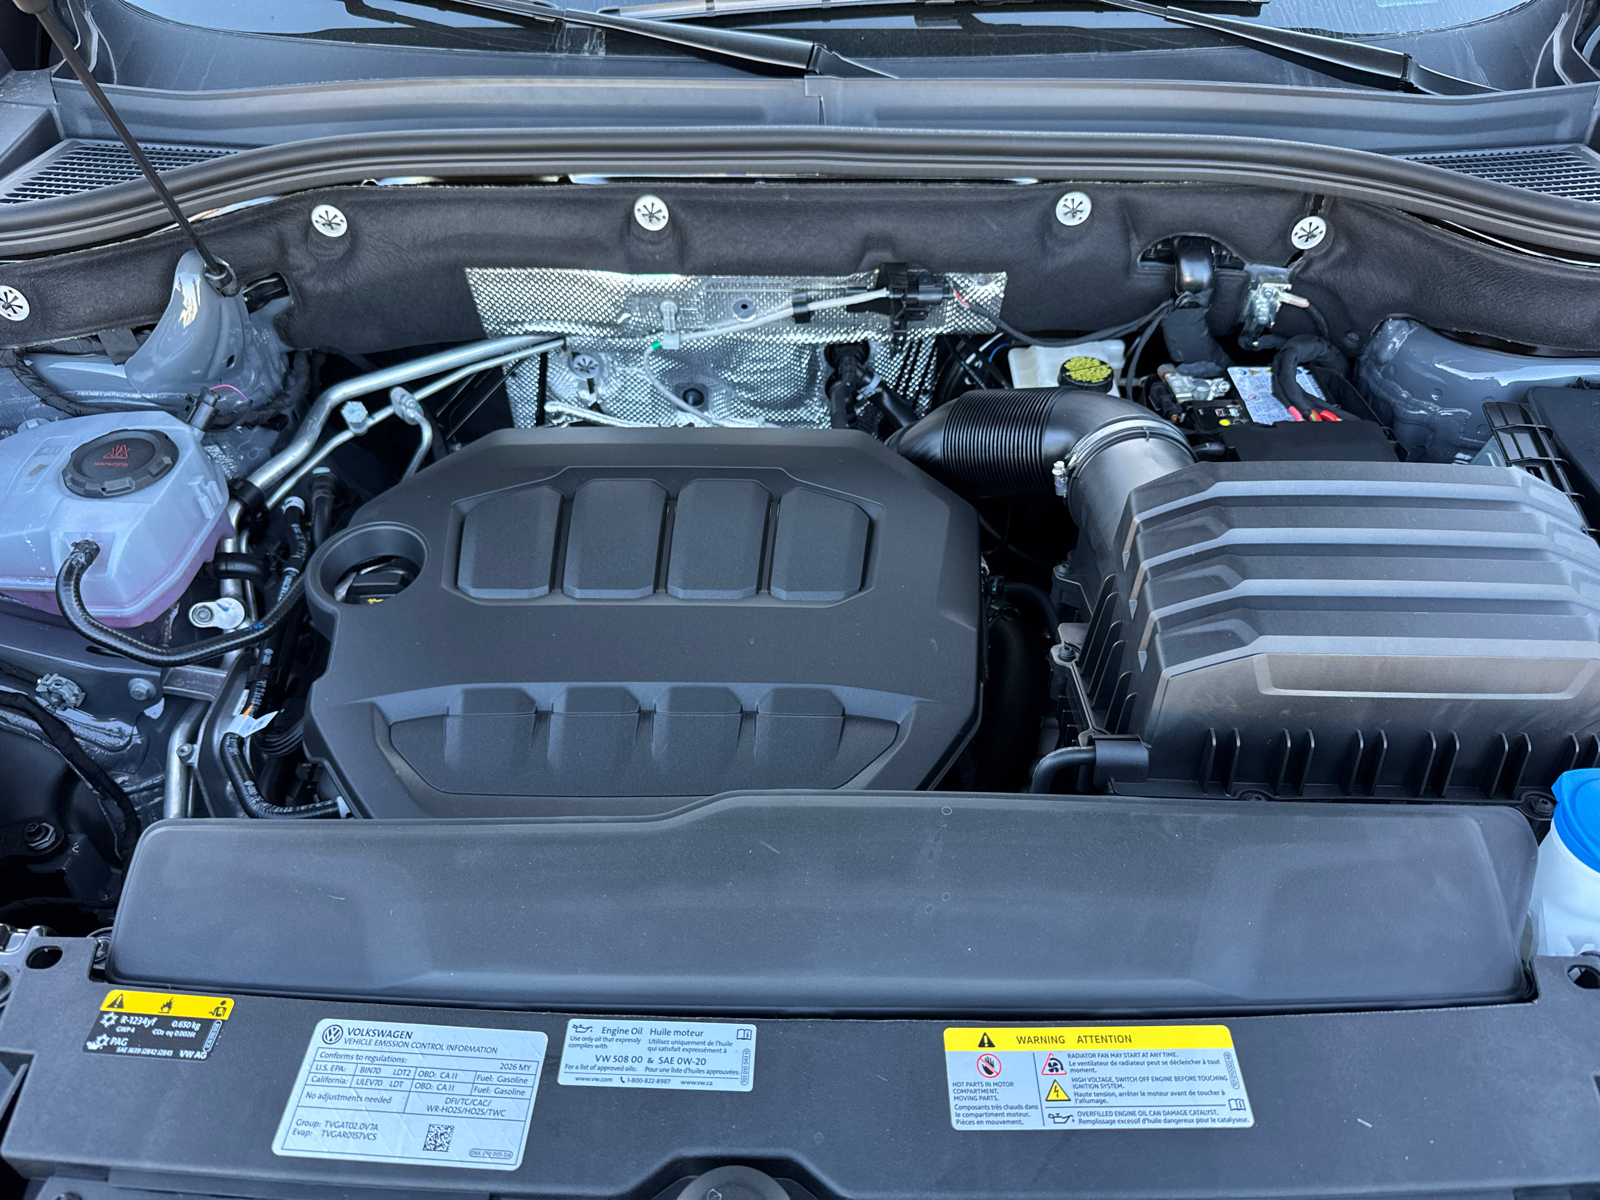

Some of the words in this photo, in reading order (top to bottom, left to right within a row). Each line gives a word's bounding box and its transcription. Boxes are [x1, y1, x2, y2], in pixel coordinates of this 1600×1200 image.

[120, 1015, 158, 1028] R-1234yf
[171, 1020, 191, 1028] 0.650
[191, 1022, 201, 1031] kg
[347, 1028, 413, 1039] VOLKSWAGEN
[602, 1027, 629, 1036] Engine
[631, 1027, 643, 1035] Oil
[650, 1028, 671, 1036] Huile
[110, 1037, 129, 1046] PAG
[1016, 1035, 1065, 1044] WARNING
[1077, 1035, 1132, 1044] ATTENTION
[374, 1039, 410, 1048] EMISSION
[411, 1042, 445, 1050] CONTROL
[446, 1044, 497, 1054] INFORMATION
[180, 1050, 194, 1058] VW
[194, 1051, 207, 1059] AG
[320, 1051, 354, 1060] Conforms
[365, 1055, 407, 1063] regulations:
[612, 1055, 629, 1063] 508
[677, 1057, 707, 1066] 0W-20
[418, 1070, 436, 1078] OBD:
[440, 1071, 451, 1079] CA
[311, 1075, 349, 1084] California:
[356, 1078, 383, 1086] ULEV70
[497, 1076, 529, 1084] Gasoline
[627, 1077, 671, 1085] 1-800-822-8987
[415, 1082, 433, 1090] OBD:
[436, 1083, 448, 1091] CA
[473, 1086, 491, 1094] Fuel:
[494, 1087, 526, 1096] Gasoline
[317, 1092, 363, 1102] adjustments
[364, 1096, 392, 1104] needed
[445, 1097, 492, 1107] DFI/TC/CAC/
[426, 1105, 506, 1116] WR-HO2S/HO2S/TWC
[295, 1119, 321, 1129] Group:
[1163, 1117, 1195, 1125] dangereux
[292, 1128, 313, 1138] Evap:
